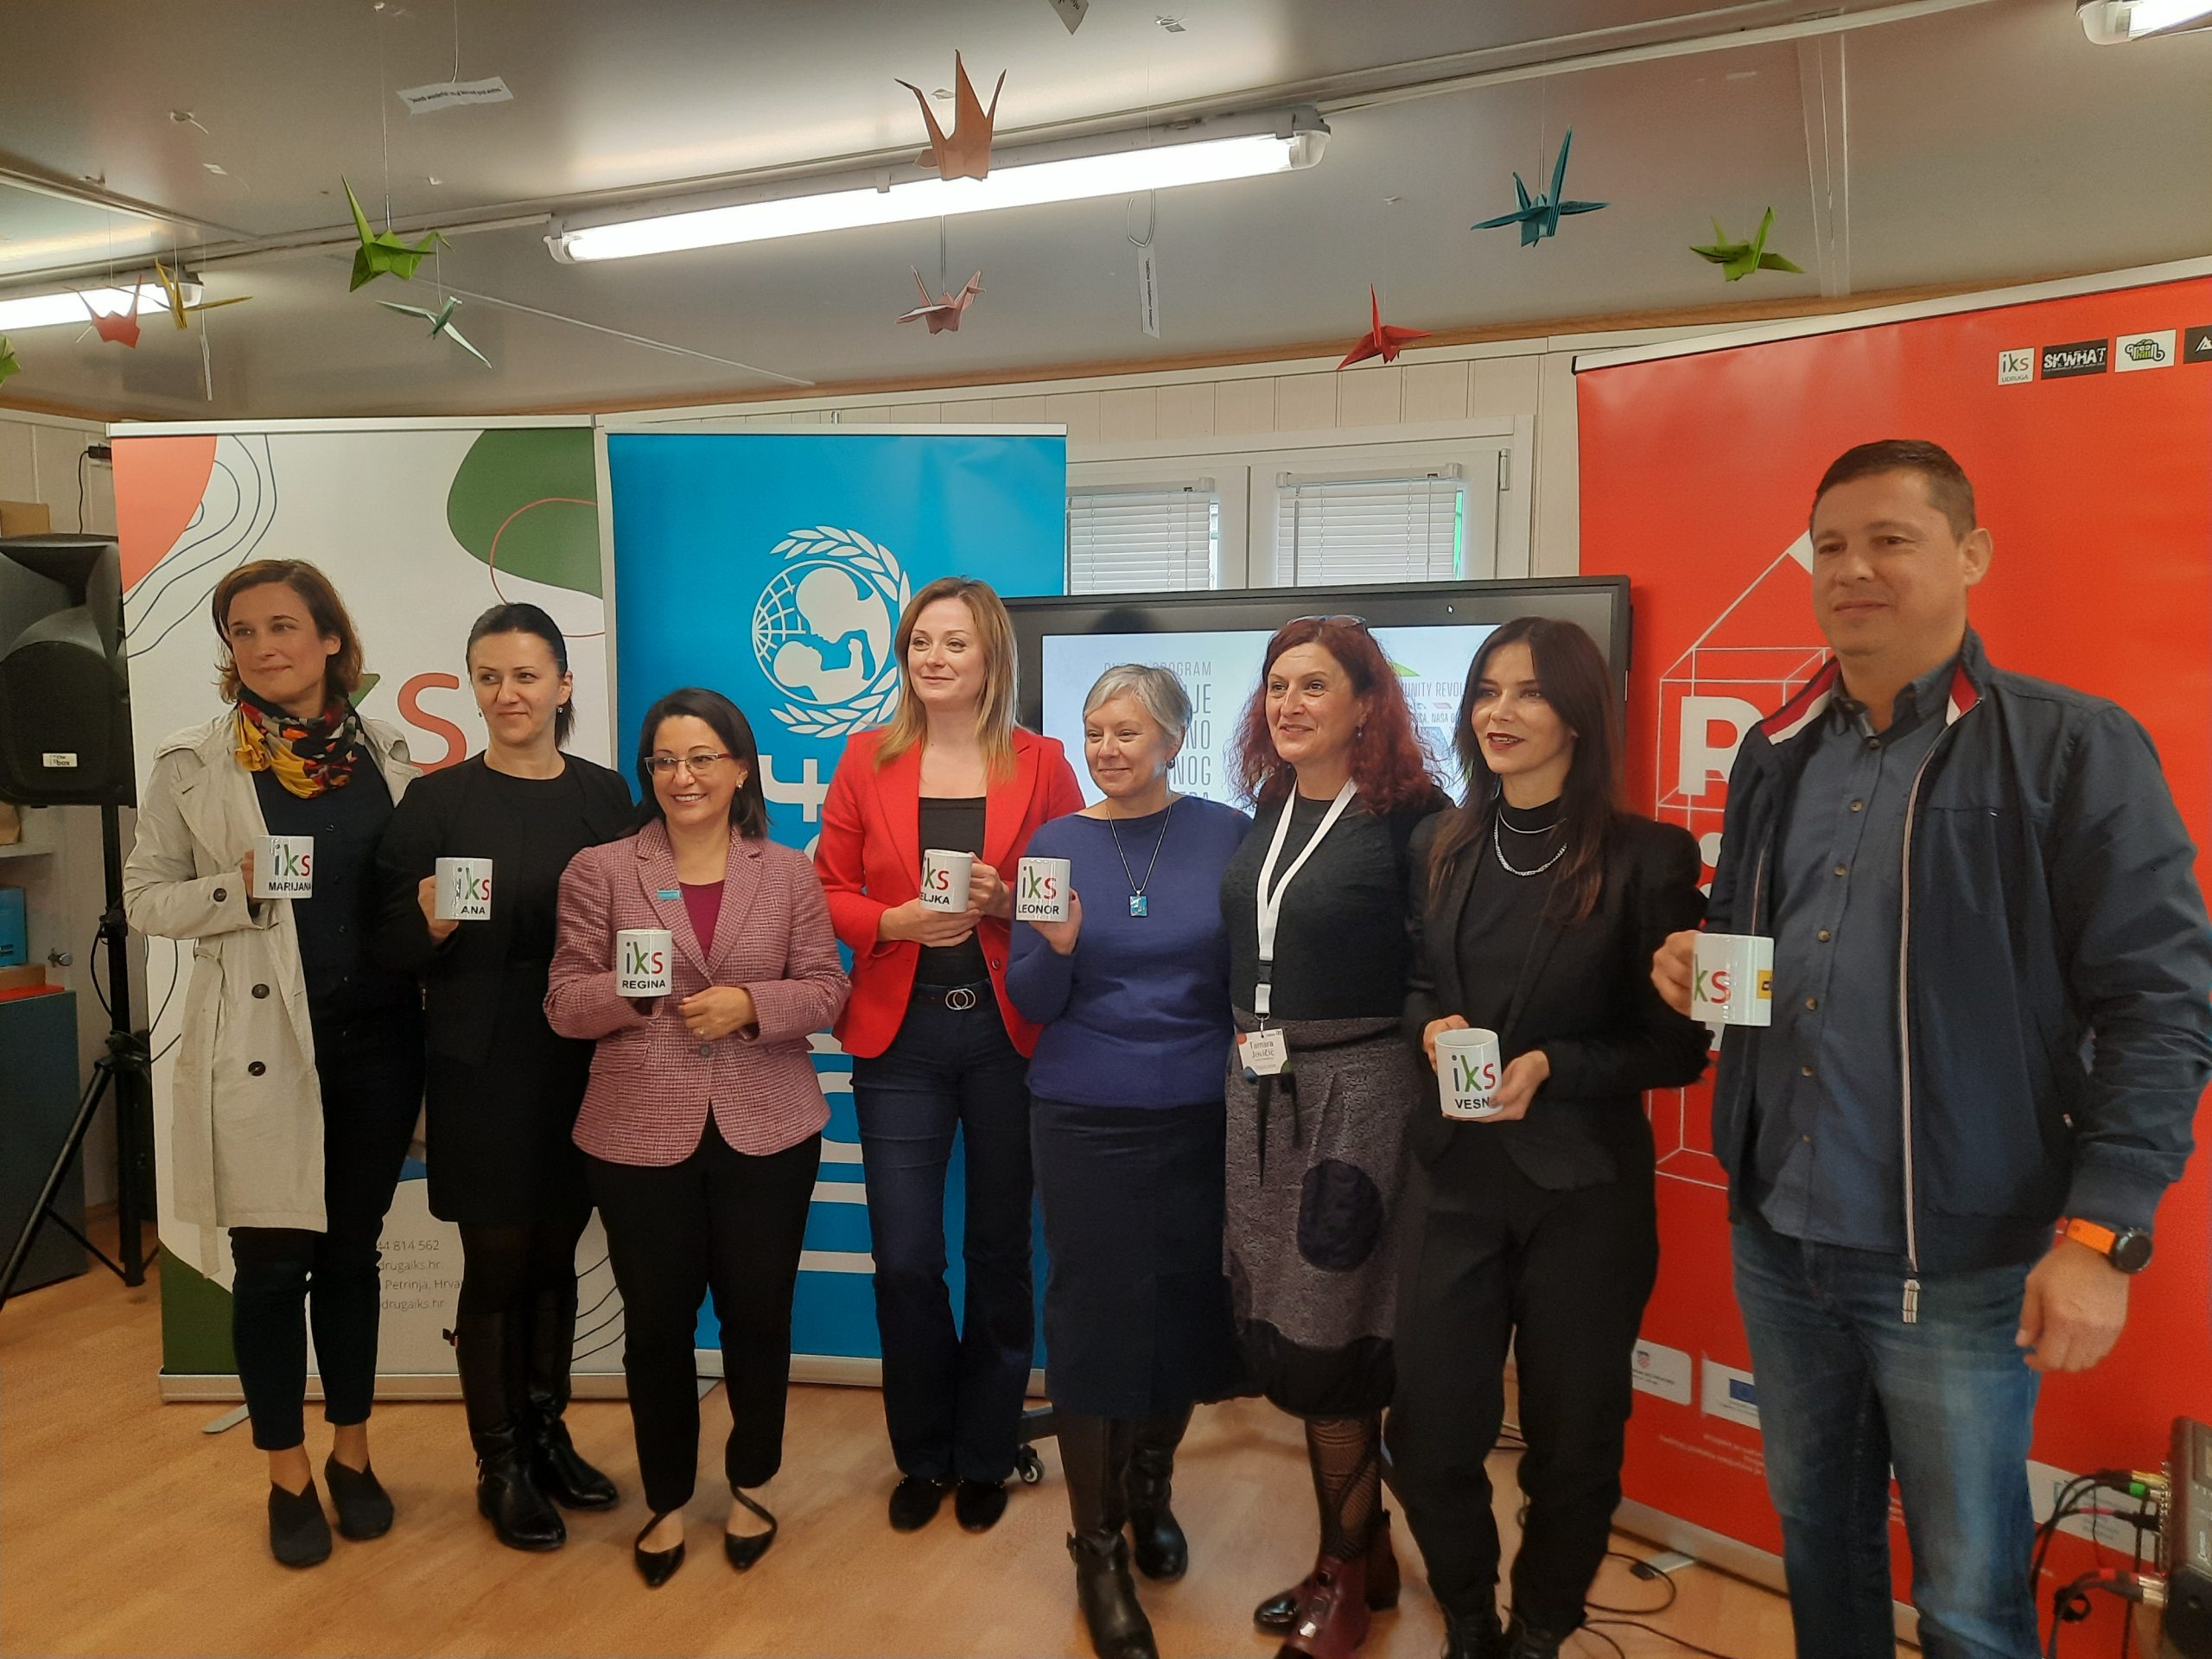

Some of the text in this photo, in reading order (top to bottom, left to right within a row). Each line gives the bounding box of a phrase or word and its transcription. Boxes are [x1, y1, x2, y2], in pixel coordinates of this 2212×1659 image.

[2002, 353, 2029, 372] iks
[2001, 374, 2029, 383] UDRUGA
[1403, 682, 1432, 697] UNITY
[275, 843, 311, 877] iks
[455, 867, 490, 900] iks
[1022, 865, 1057, 899] iks
[919, 891, 950, 905] ELJKA
[461, 906, 486, 914] ANA
[1018, 904, 1059, 915] LEONOR
[626, 941, 664, 975] iks
[621, 979, 666, 989] REGINA
[1694, 953, 1732, 1004] ks
[1452, 1054, 1496, 1092] iks
[1455, 1096, 1491, 1109] VESN
[394, 1241, 415, 1250] 814
[418, 1240, 440, 1251] 562
[378, 1260, 442, 1274] drugaiks.hr
[435, 1279, 461, 1289] Hrva
[382, 1299, 445, 1312] drugaiks.hr
